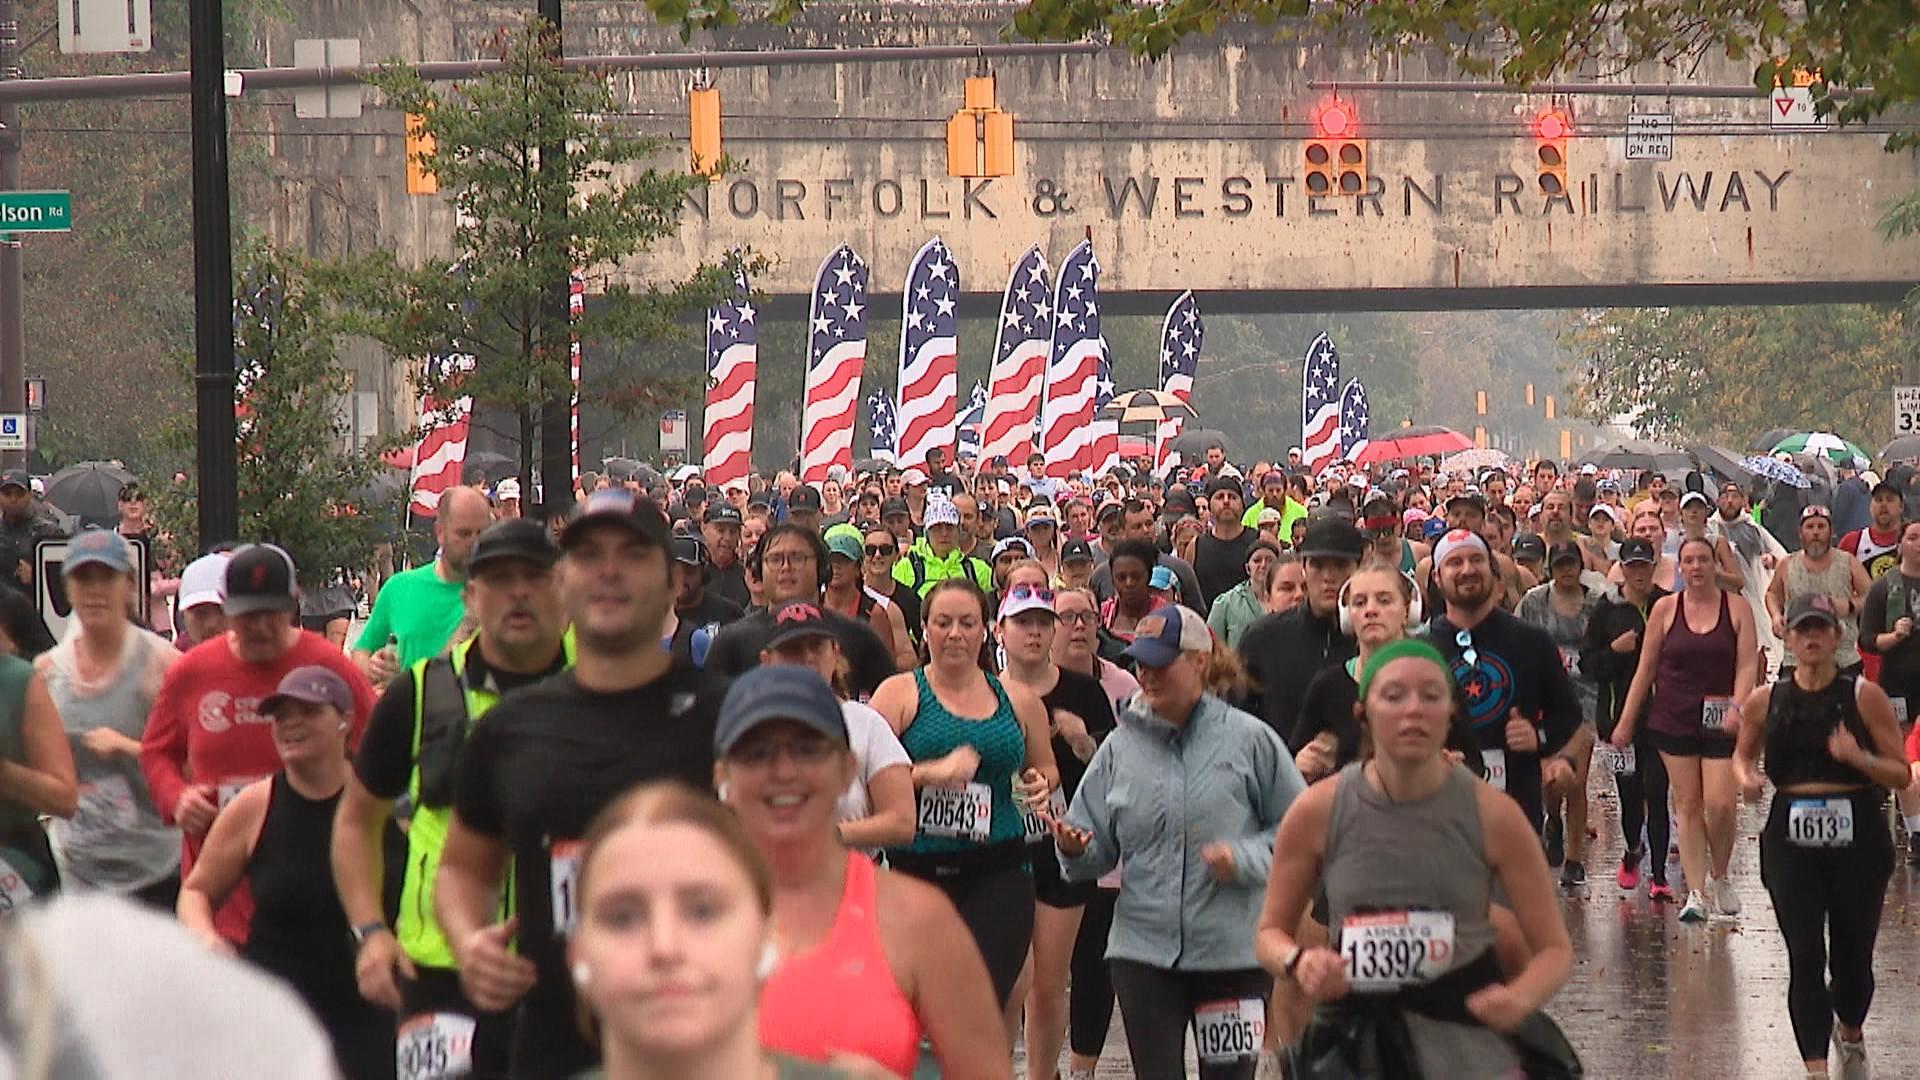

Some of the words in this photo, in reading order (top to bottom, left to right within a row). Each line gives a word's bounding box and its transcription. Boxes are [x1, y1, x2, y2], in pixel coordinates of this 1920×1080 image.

[1641, 119, 1658, 128] NO
[1630, 145, 1643, 155] ON
[1649, 145, 1669, 155] RED
[684, 178, 997, 221] NORFOLK
[1032, 178, 1076, 219] &
[1494, 169, 1794, 216] RAILWAY
[0, 203, 42, 222] lson
[49, 206, 63, 217] Rd
